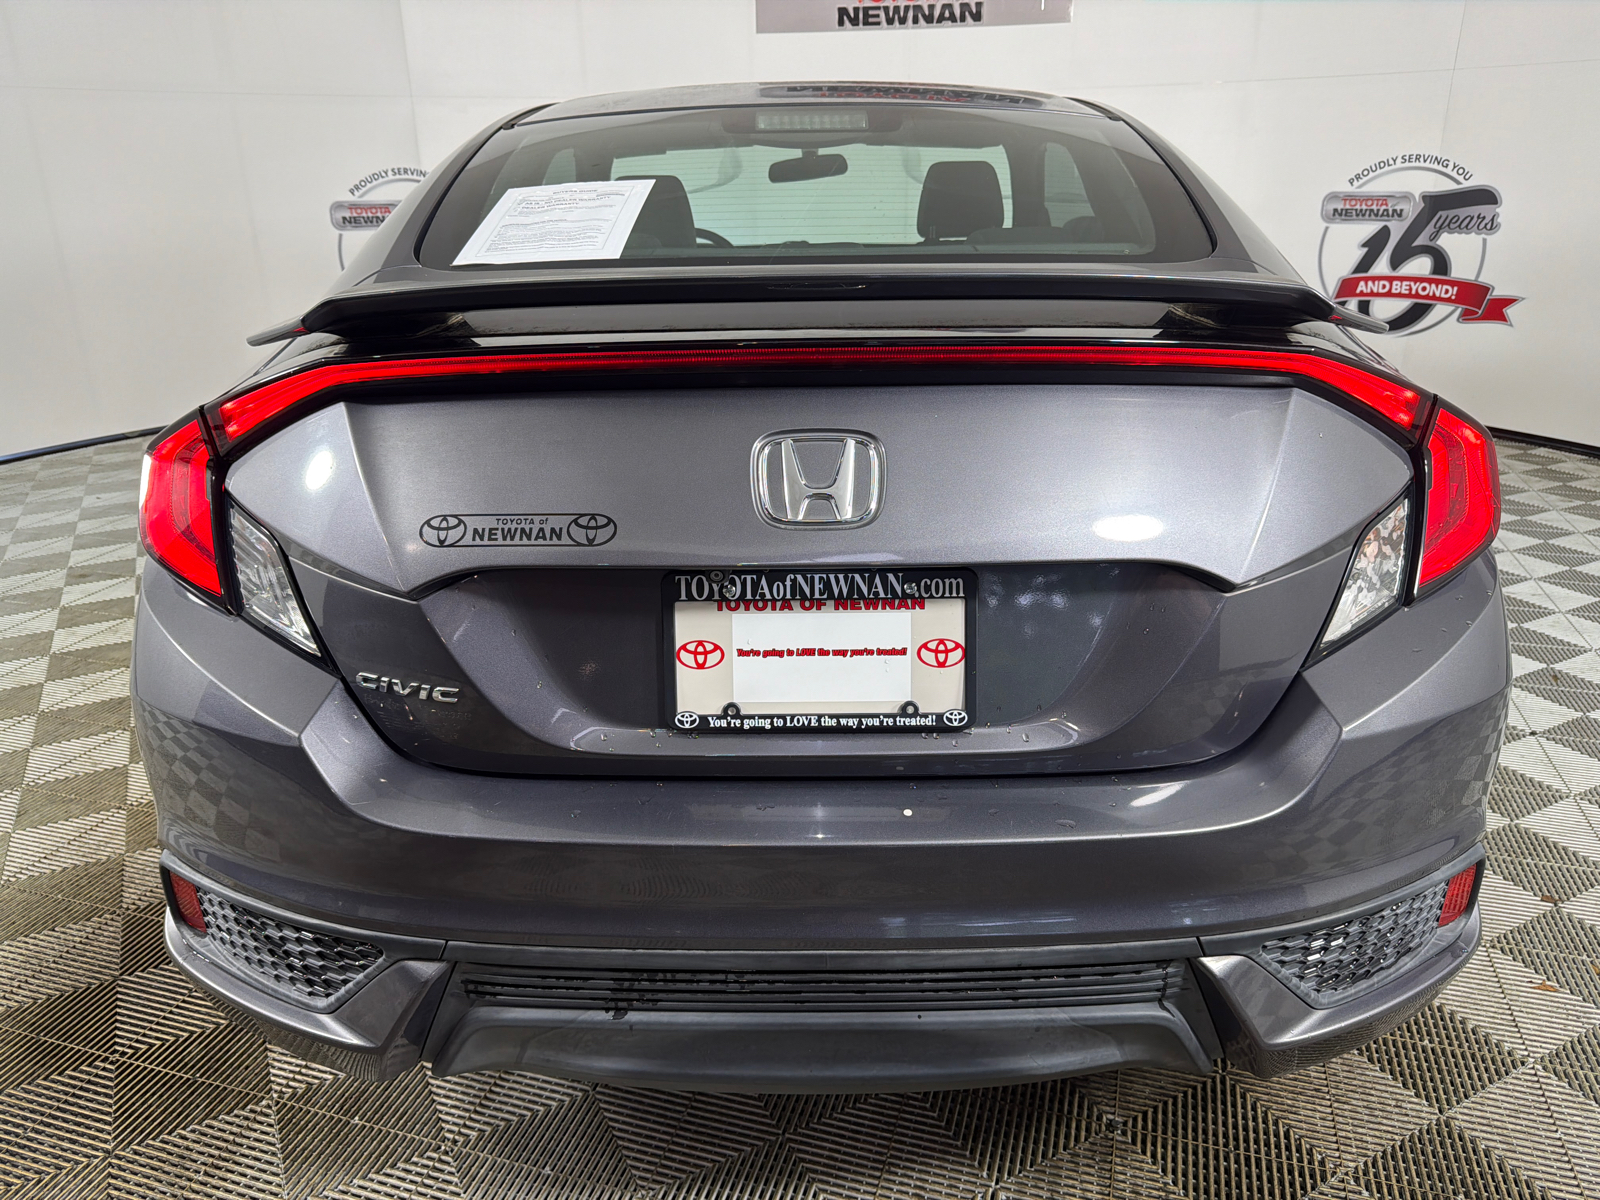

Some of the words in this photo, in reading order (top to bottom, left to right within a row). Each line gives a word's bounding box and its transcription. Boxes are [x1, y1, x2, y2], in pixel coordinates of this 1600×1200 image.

[837, 2, 983, 27] NEWNAN
[1347, 156, 1399, 187] PROUDLY
[1401, 154, 1450, 169] SERVING
[1451, 162, 1473, 182] YOU
[348, 169, 389, 197] PROUDLY
[391, 167, 430, 178] SERVIN
[347, 206, 392, 216] TOYOTA
[1341, 198, 1390, 209] TOYOTA
[341, 215, 390, 226] NEWN
[1332, 208, 1404, 219] NEWNAN
[1428, 212, 1499, 243] years
[1356, 281, 1390, 294] AND
[1391, 281, 1457, 299] BEYOND!
[495, 517, 535, 526] TOYOTA
[538, 517, 549, 526] of
[471, 527, 563, 542] NEWNAN
[716, 600, 794, 612] TOYOTA
[800, 600, 827, 611] OF
[834, 598, 926, 611] NEWNAN
[736, 648, 761, 657] You're
[762, 648, 785, 659] going
[786, 648, 795, 657] to
[796, 648, 816, 657] LOVE
[817, 648, 830, 656] the
[832, 649, 849, 658] way
[849, 648, 875, 658] you're
[876, 647, 908, 656] treated!
[355, 672, 460, 703] CIVIC
[707, 716, 742, 727] You're
[743, 716, 772, 729] going
[773, 716, 784, 727] to
[785, 715, 819, 727] LOVE
[820, 715, 838, 726] the
[839, 717, 860, 729] way
[861, 715, 894, 729] you're
[895, 714, 937, 726] treated!
